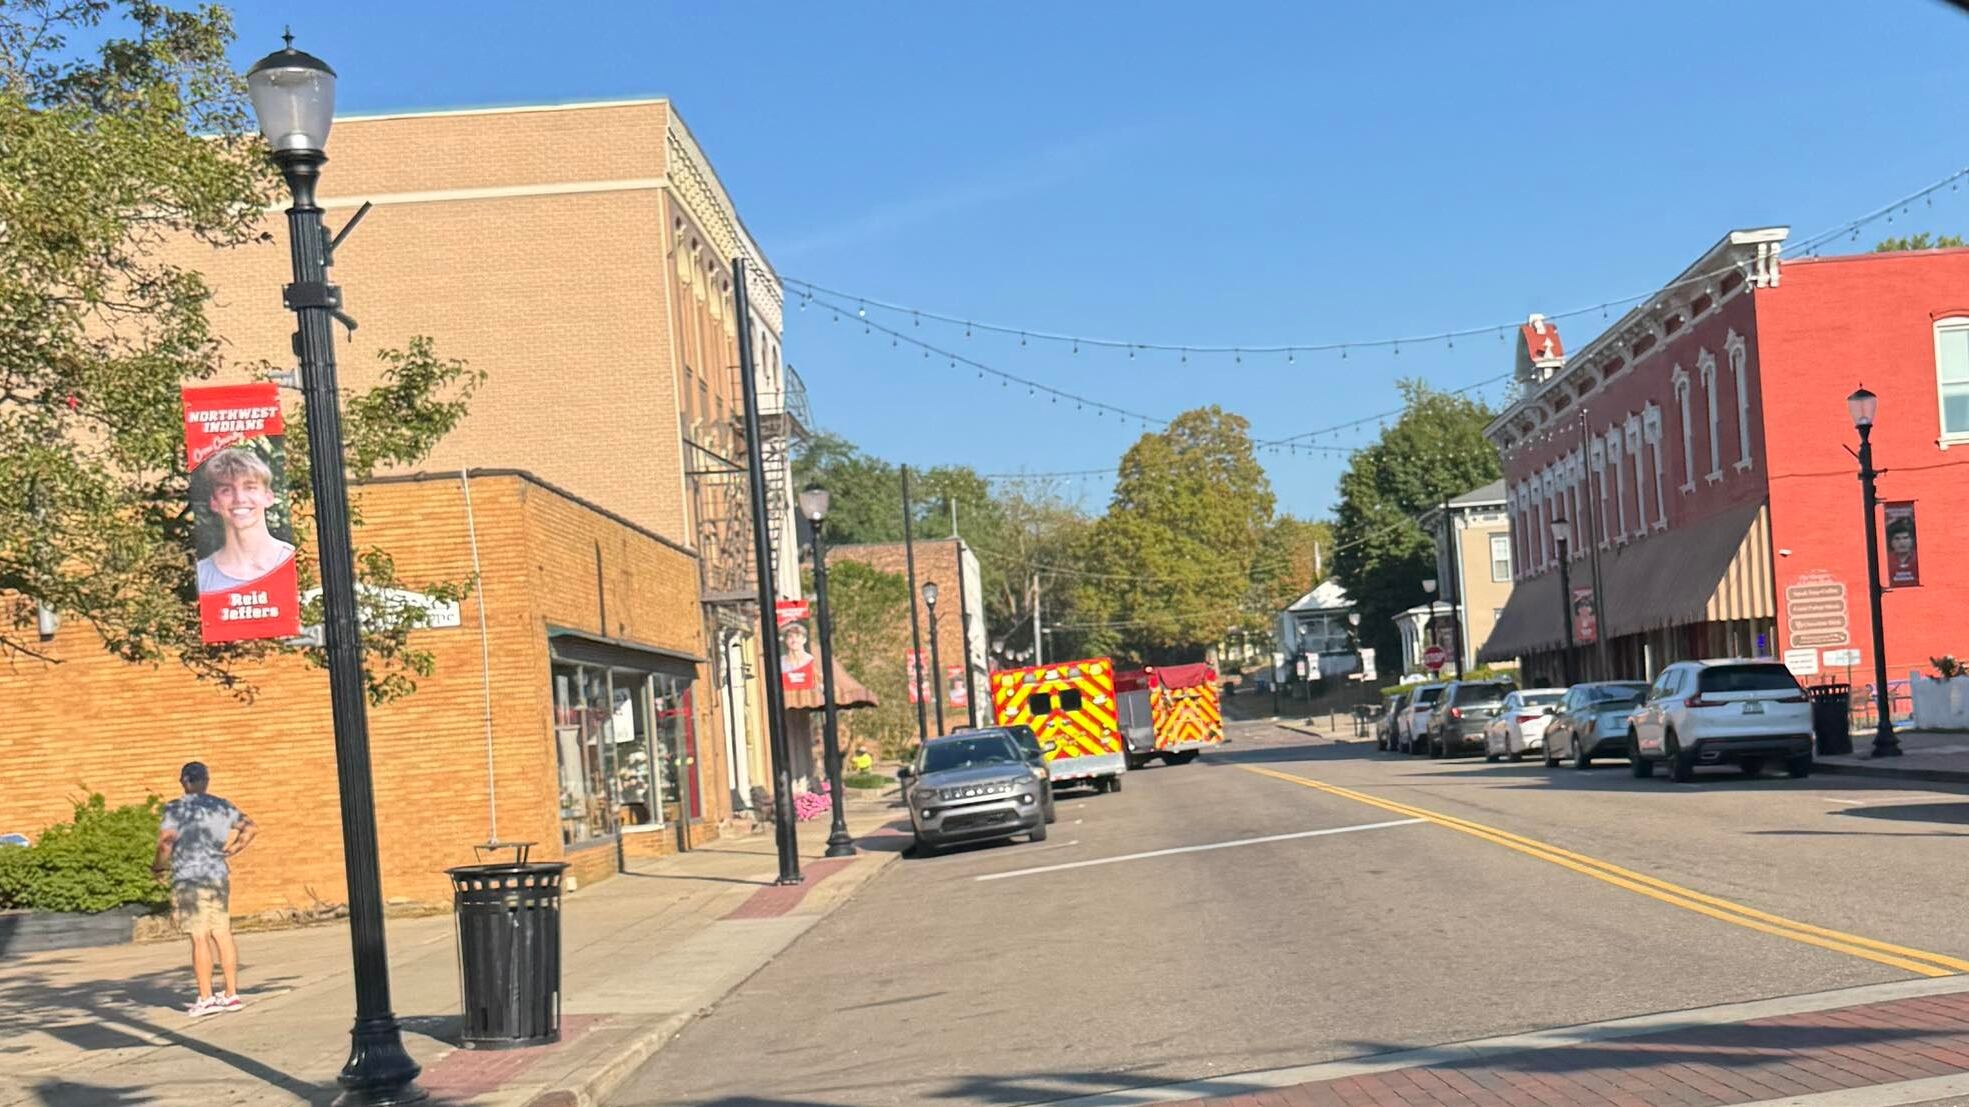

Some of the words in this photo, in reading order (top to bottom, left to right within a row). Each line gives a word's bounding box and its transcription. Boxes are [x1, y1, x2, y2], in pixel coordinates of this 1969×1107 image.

[188, 406, 278, 423] NORTHWEST
[204, 419, 265, 432] INDIANS
[229, 590, 268, 606] Reid
[220, 606, 279, 621] Jeffers
